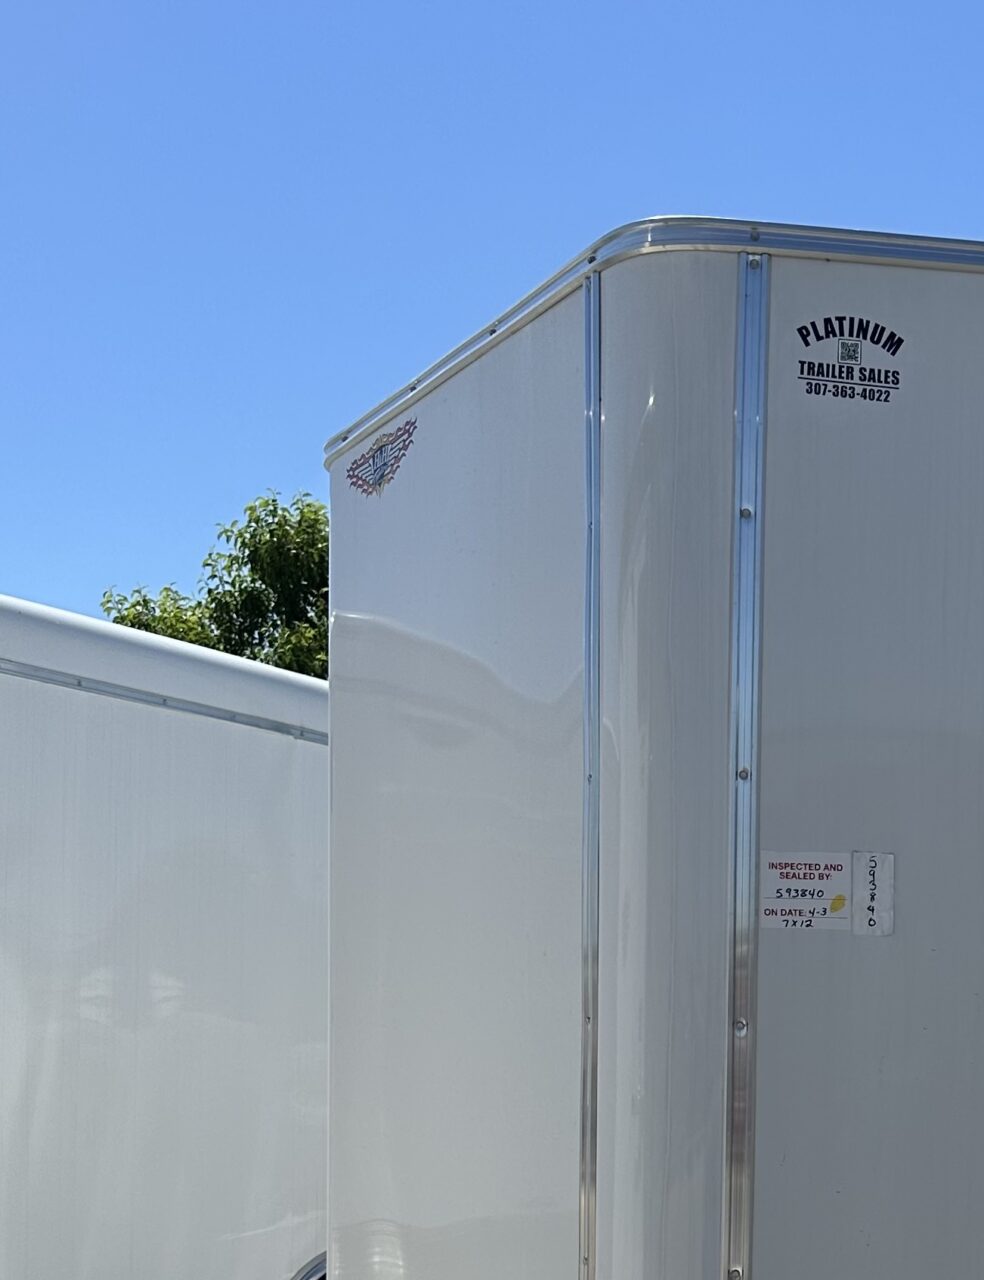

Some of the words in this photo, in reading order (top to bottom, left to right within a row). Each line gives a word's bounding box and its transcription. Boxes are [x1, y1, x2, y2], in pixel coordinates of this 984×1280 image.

[796, 316, 905, 357] PLATINUM
[798, 360, 855, 381] TRAILER
[858, 367, 900, 386] SALES
[805, 381, 891, 403] 307-363-4022
[768, 862, 821, 872] INSPECTED
[823, 863, 844, 872] AND
[779, 872, 816, 881] SEALED
[818, 873, 833, 881] BY:
[775, 888, 825, 899] 593840
[764, 908, 778, 917] ON
